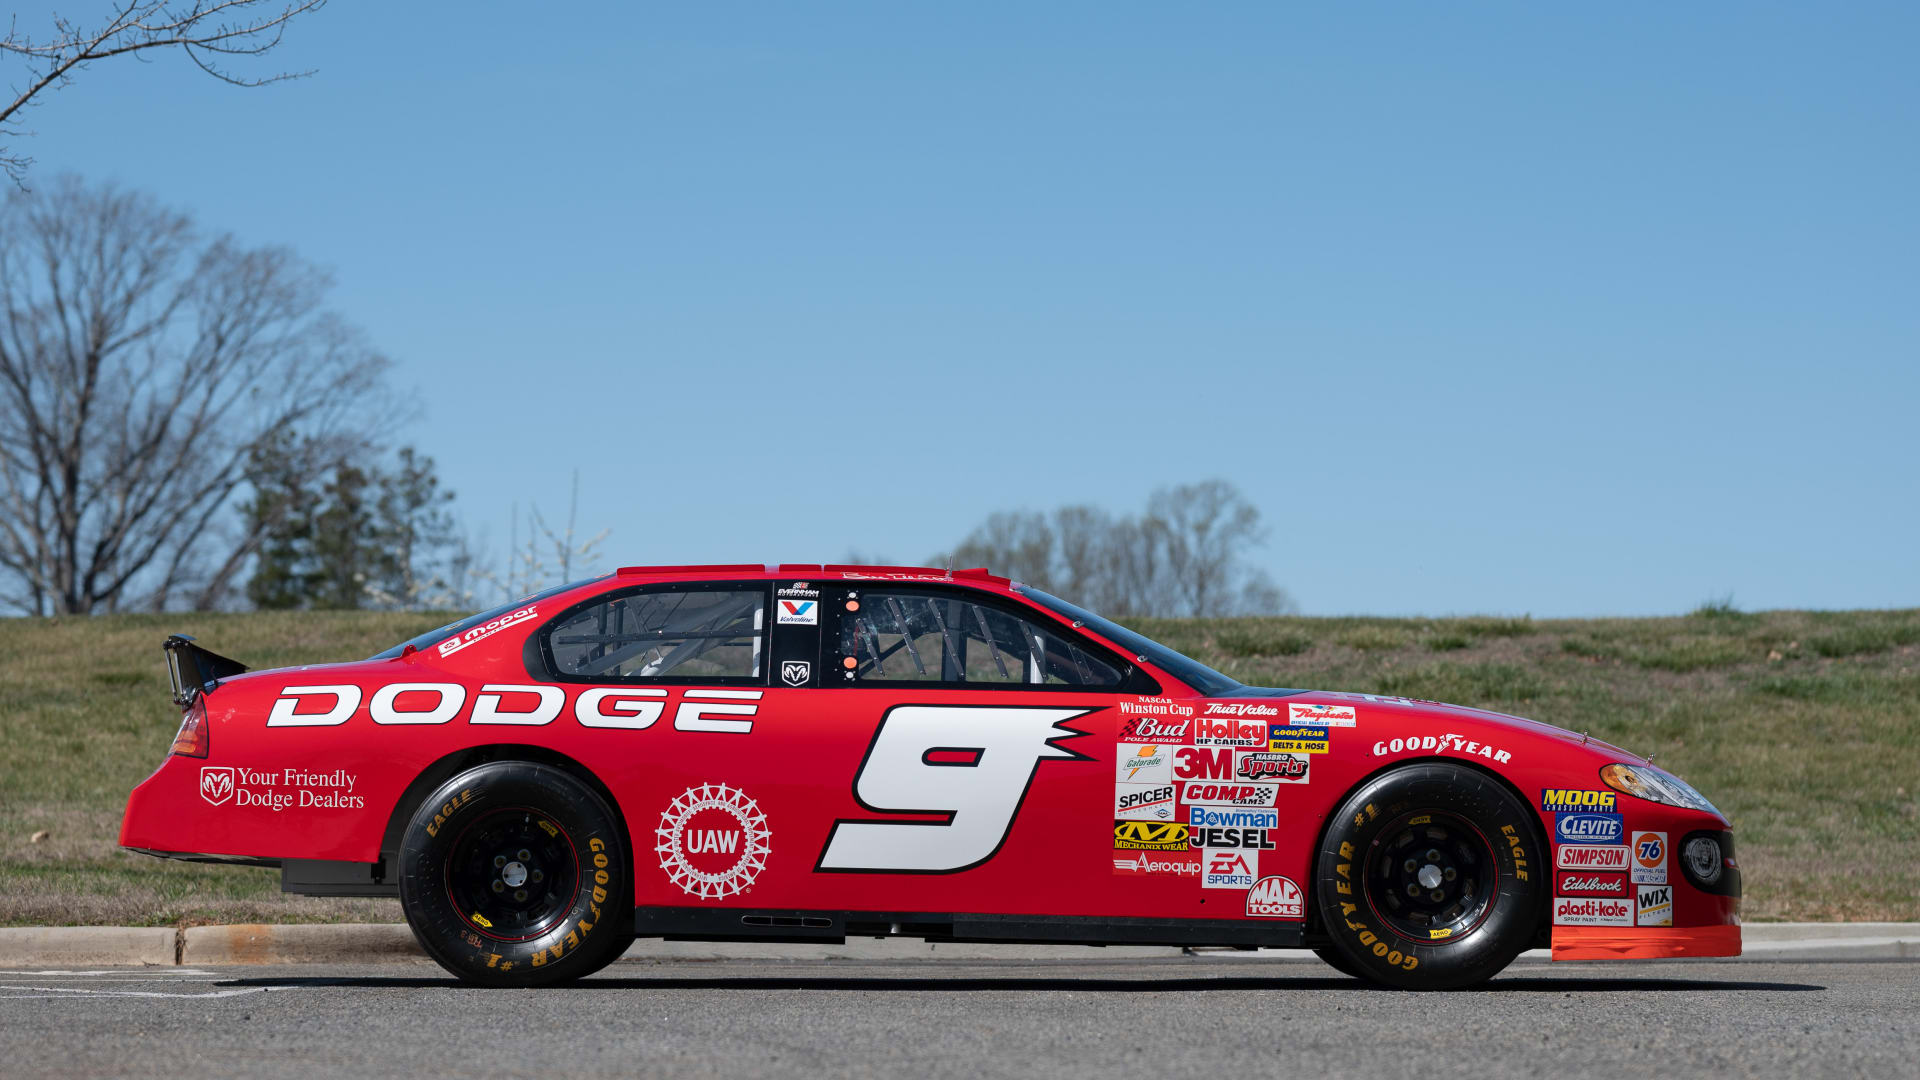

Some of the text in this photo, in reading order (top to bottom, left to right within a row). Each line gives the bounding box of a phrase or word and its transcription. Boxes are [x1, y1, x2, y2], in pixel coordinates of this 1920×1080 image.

[265, 683, 765, 734] DODGE
[1138, 695, 1173, 704] NASCAR
[1120, 702, 1194, 717] Winston Cup
[1135, 718, 1191, 737] Bud
[1196, 719, 1266, 746] Holley
[1273, 728, 1325, 738] GOODYEAR
[1196, 738, 1212, 746] HP
[1273, 741, 1325, 751] BELTS & HOSE
[1373, 734, 1512, 765] GOODYEAR
[1126, 757, 1162, 769] Gatorade
[1174, 747, 1233, 780] 3M
[1238, 755, 1306, 778] Sports
[1255, 753, 1288, 761] HASBRO
[237, 768, 357, 793] Your Friendly
[812, 703, 1110, 876] 9
[236, 789, 365, 811] Dodge Dealers
[1119, 787, 1173, 808] SPICER
[1186, 785, 1256, 801] COMP
[1543, 789, 1616, 806] MOOG
[426, 788, 473, 838] EAGLE
[1546, 804, 1582, 812] CHASSIS
[1560, 816, 1618, 835] CLEVITE
[687, 829, 740, 854] UAW
[1114, 839, 1189, 851] MECHANIX WEAR
[1190, 827, 1276, 849] JESEL
[1501, 824, 1529, 882] EAGLE
[1563, 848, 1625, 865] SIMPSON
[1639, 840, 1661, 859] 76
[1136, 851, 1202, 876] Aeroquip
[1208, 853, 1252, 875] EA
[1207, 875, 1252, 885] SPORTS
[1562, 876, 1622, 892] Edelbrock
[1249, 878, 1302, 905] MAC
[1638, 887, 1670, 908] WIX
[531, 837, 609, 968] GOODYEAR
[1249, 903, 1301, 915] TOOLS
[1336, 841, 1419, 971] GOODYEAR
[1558, 900, 1628, 917] plasti-kote
[486, 953, 514, 971] #1
